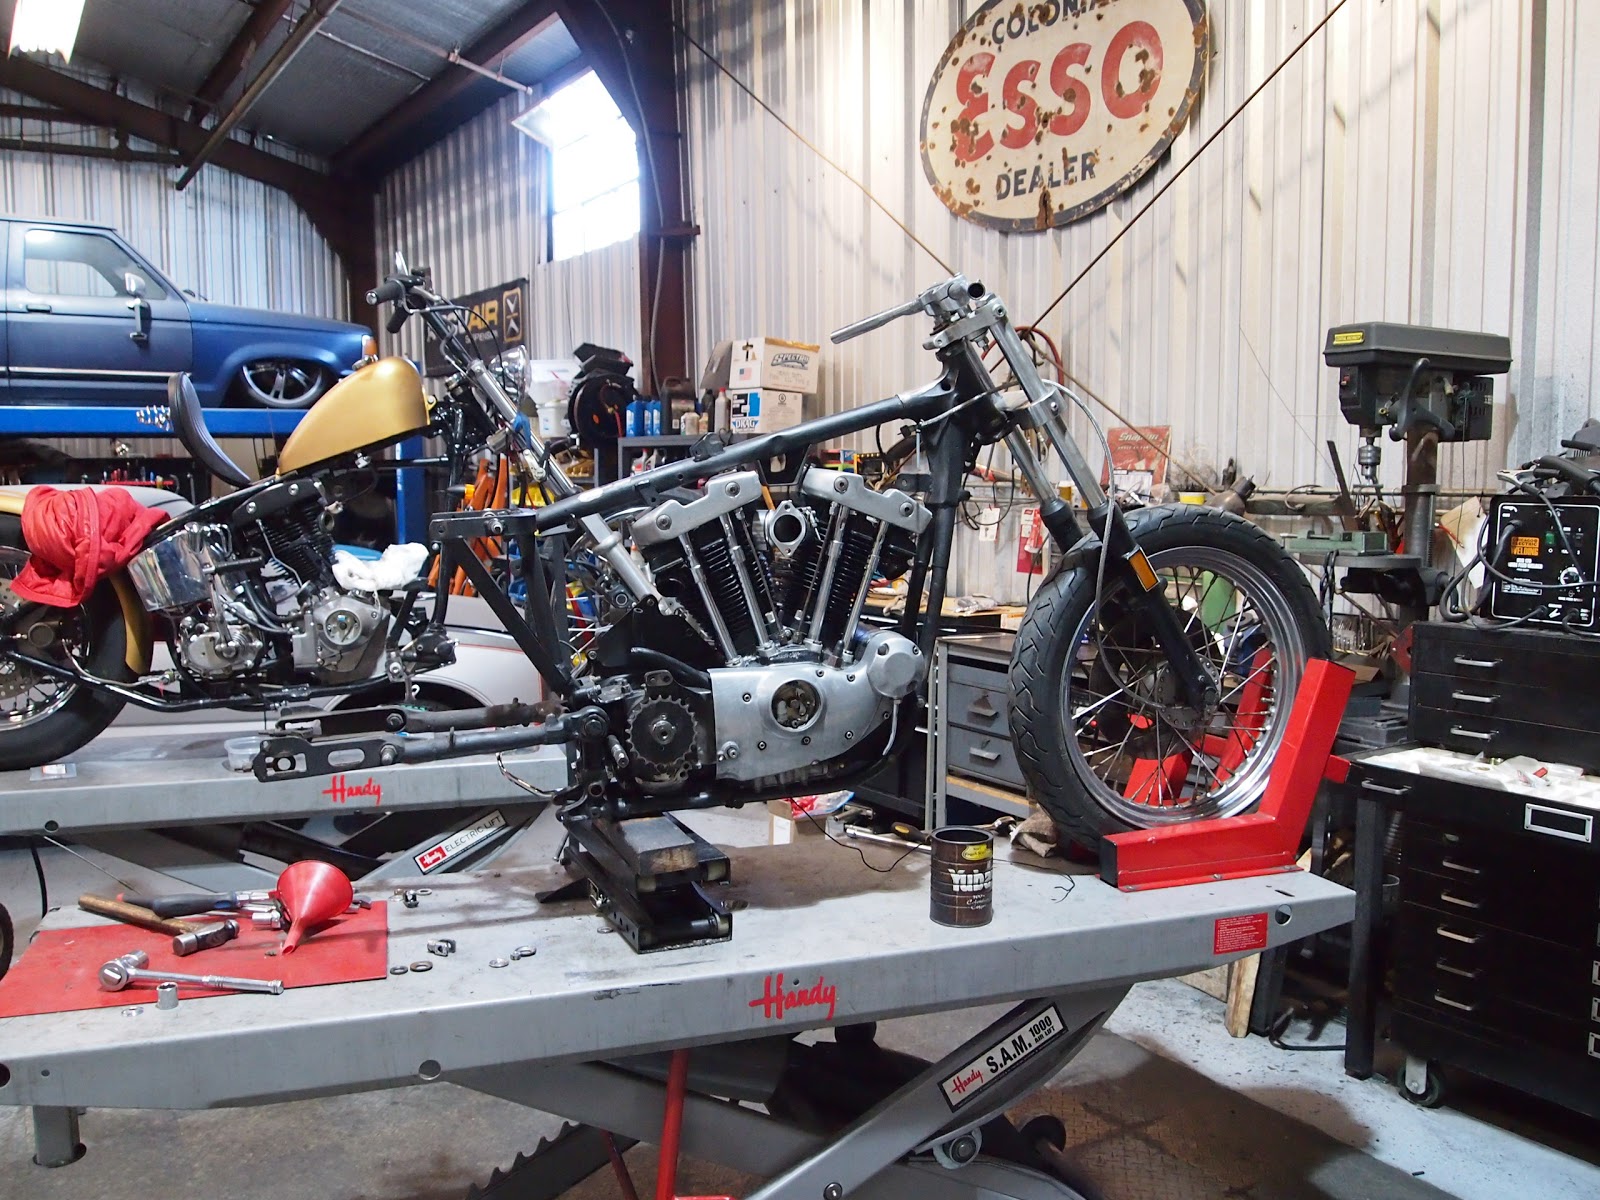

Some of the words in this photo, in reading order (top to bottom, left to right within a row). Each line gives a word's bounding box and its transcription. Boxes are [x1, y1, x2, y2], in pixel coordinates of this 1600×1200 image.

[954, 20, 1164, 162] ESSO
[996, 150, 1097, 200] DEALER
[322, 775, 383, 806] Handy
[444, 827, 484, 853] ELECTRIC
[483, 815, 501, 830] LIFT
[748, 973, 836, 1021] Handy
[951, 1069, 984, 1094] Handy
[986, 1034, 1033, 1073] S.A.M.
[1028, 1015, 1053, 1037] 1000
[1034, 1034, 1044, 1043] AIR
[1044, 1026, 1055, 1036] LIFT
